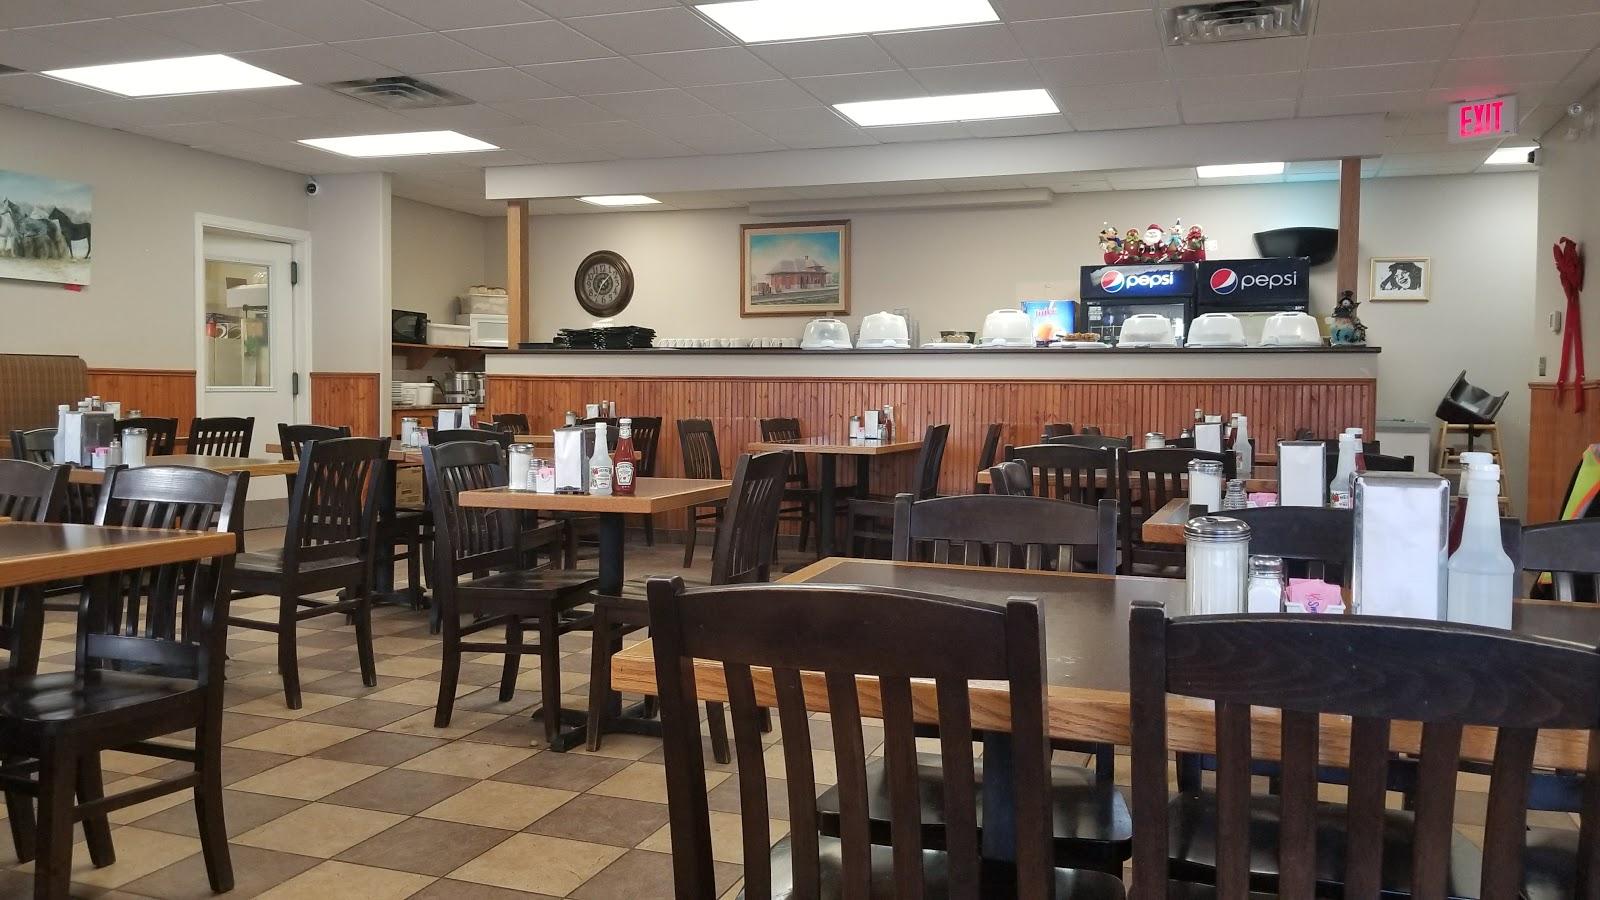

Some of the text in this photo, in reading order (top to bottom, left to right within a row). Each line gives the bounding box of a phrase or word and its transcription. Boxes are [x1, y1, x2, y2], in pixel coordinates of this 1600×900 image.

[1460, 101, 1504, 138] EXIT
[1126, 271, 1174, 289] pepsi
[1241, 271, 1297, 290] pepsi
